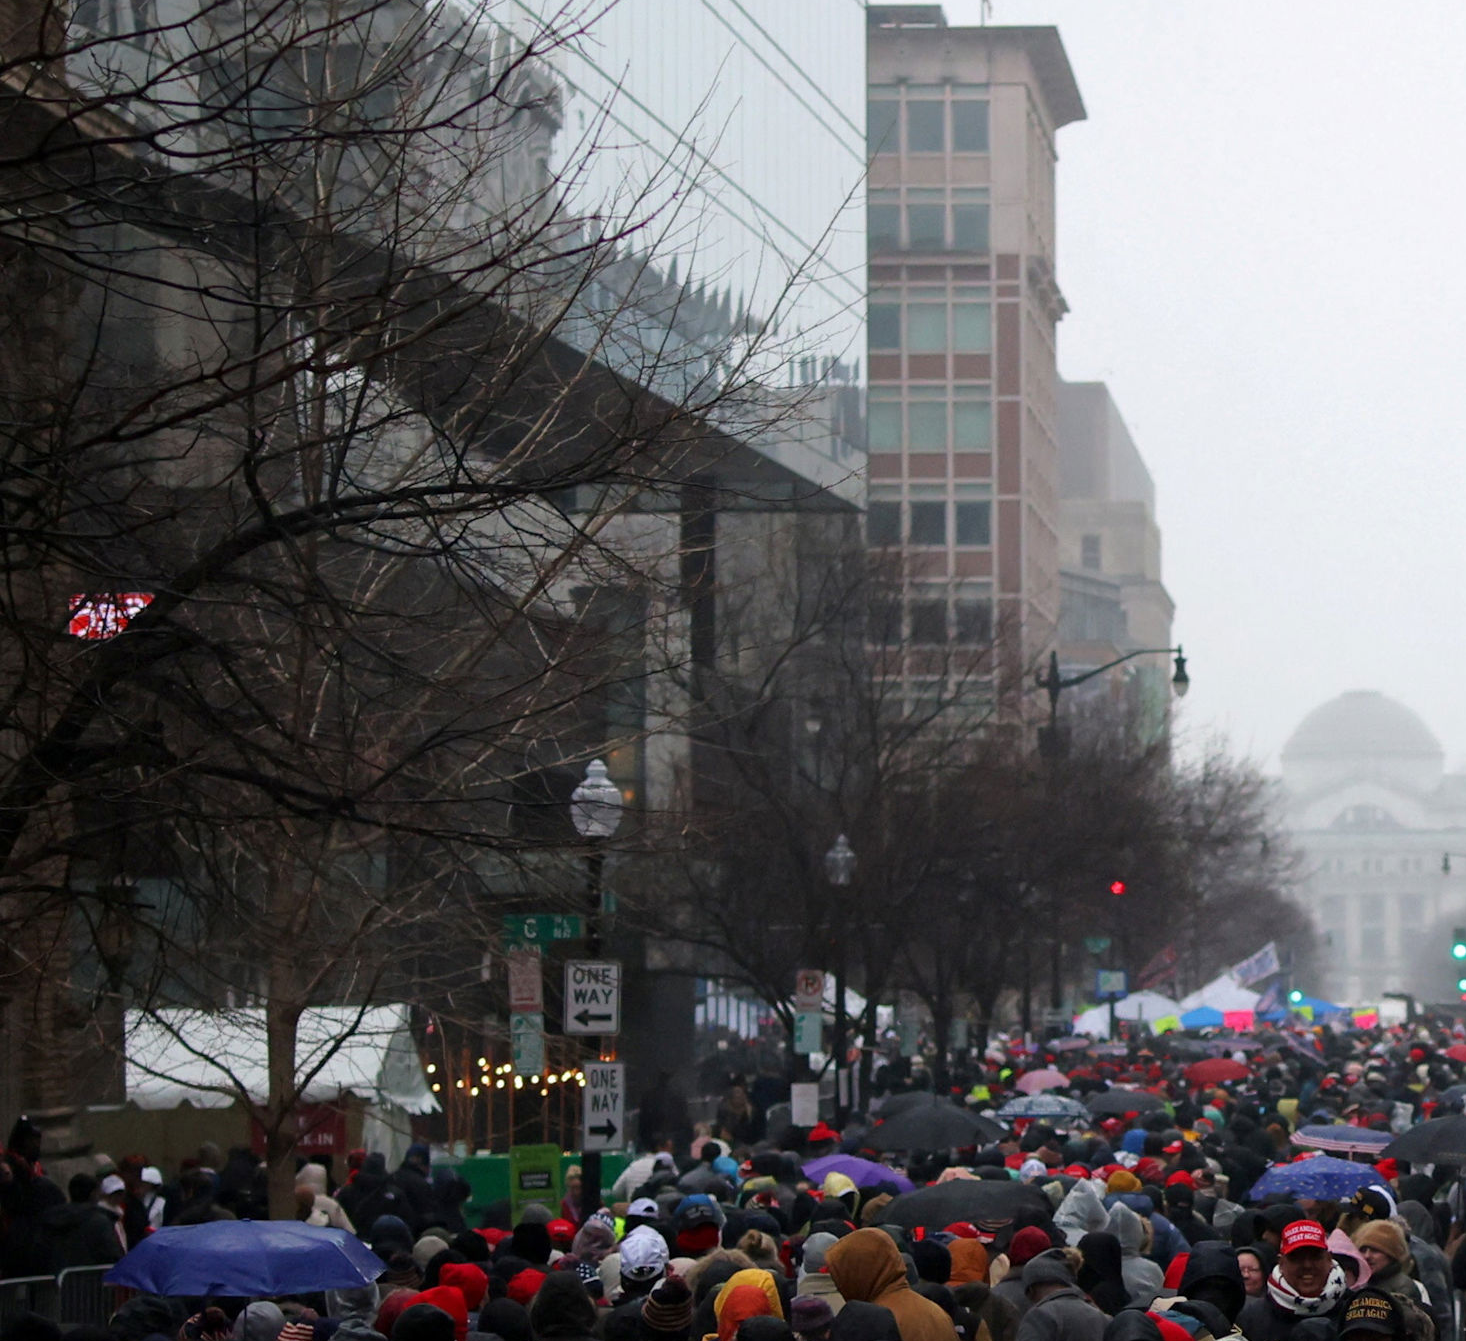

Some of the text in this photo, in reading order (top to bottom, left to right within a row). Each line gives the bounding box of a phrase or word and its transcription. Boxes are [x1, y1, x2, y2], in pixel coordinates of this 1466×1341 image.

[573, 968, 612, 984] ONE
[573, 989, 613, 1004] WAY
[591, 1070, 617, 1088] ONE
[591, 1093, 619, 1112] WAY
